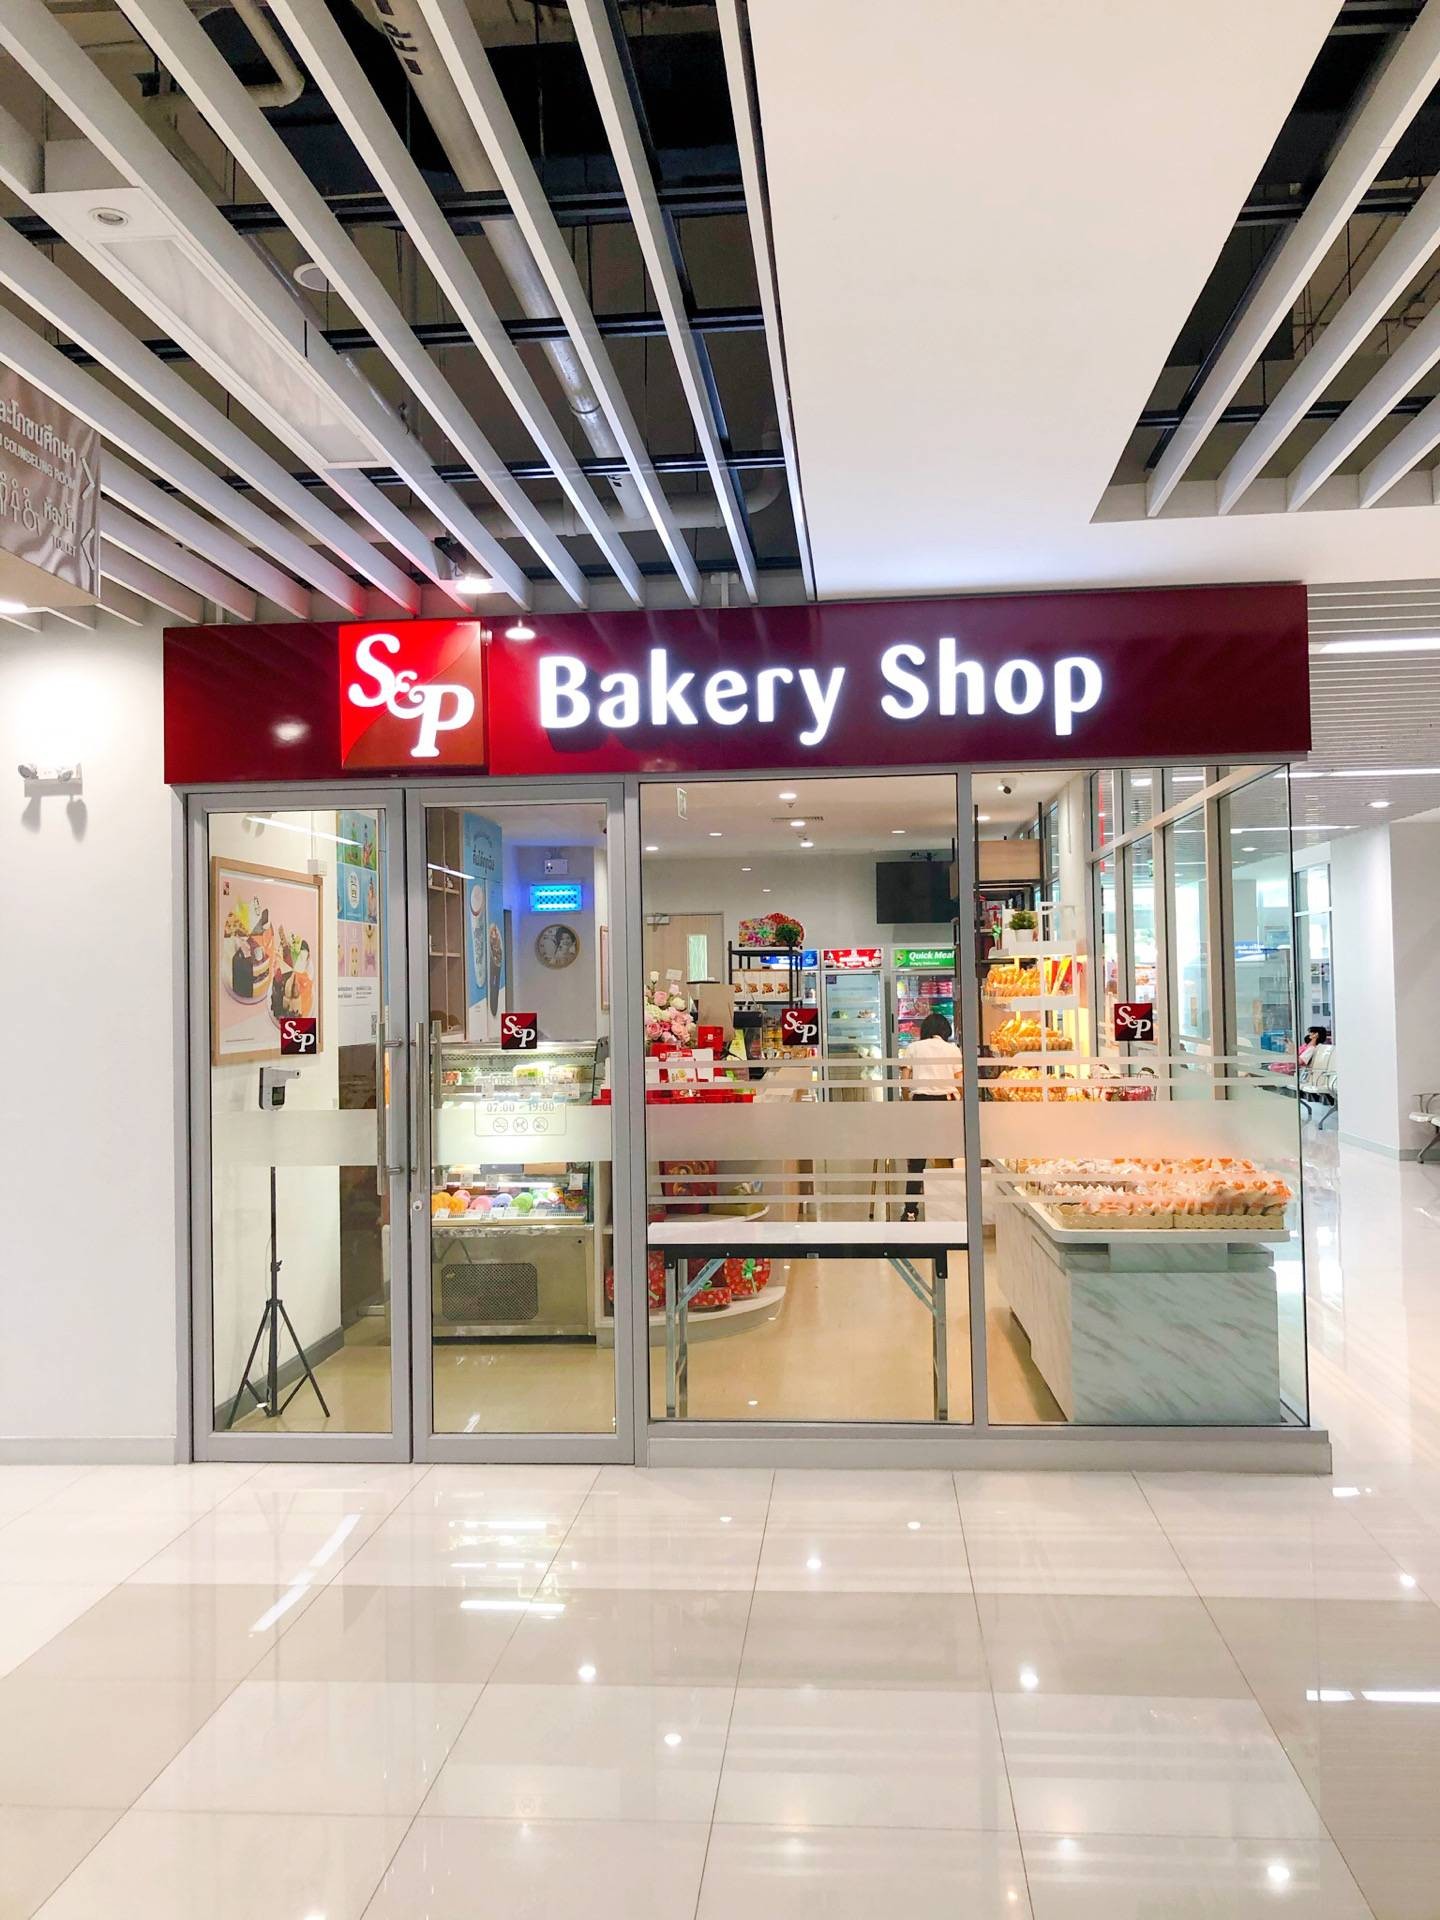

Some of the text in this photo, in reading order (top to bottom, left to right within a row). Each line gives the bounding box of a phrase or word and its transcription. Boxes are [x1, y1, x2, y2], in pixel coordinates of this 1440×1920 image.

[4, 435, 53, 477] COUNSELING
[53, 465, 77, 490] ROOM
[43, 497, 76, 534] ห้องน้ำ
[51, 535, 77, 556] TOILET
[347, 633, 1104, 758] S&P Bakery Shop
[909, 950, 954, 961] Quick Meal
[282, 1020, 315, 1053] S&P
[503, 1015, 536, 1048] S&P
[783, 1010, 817, 1044] S&P
[1116, 1005, 1151, 1039] S&P
[486, 1102, 515, 1112] 07:00
[529, 1102, 555, 1112] 19:00
